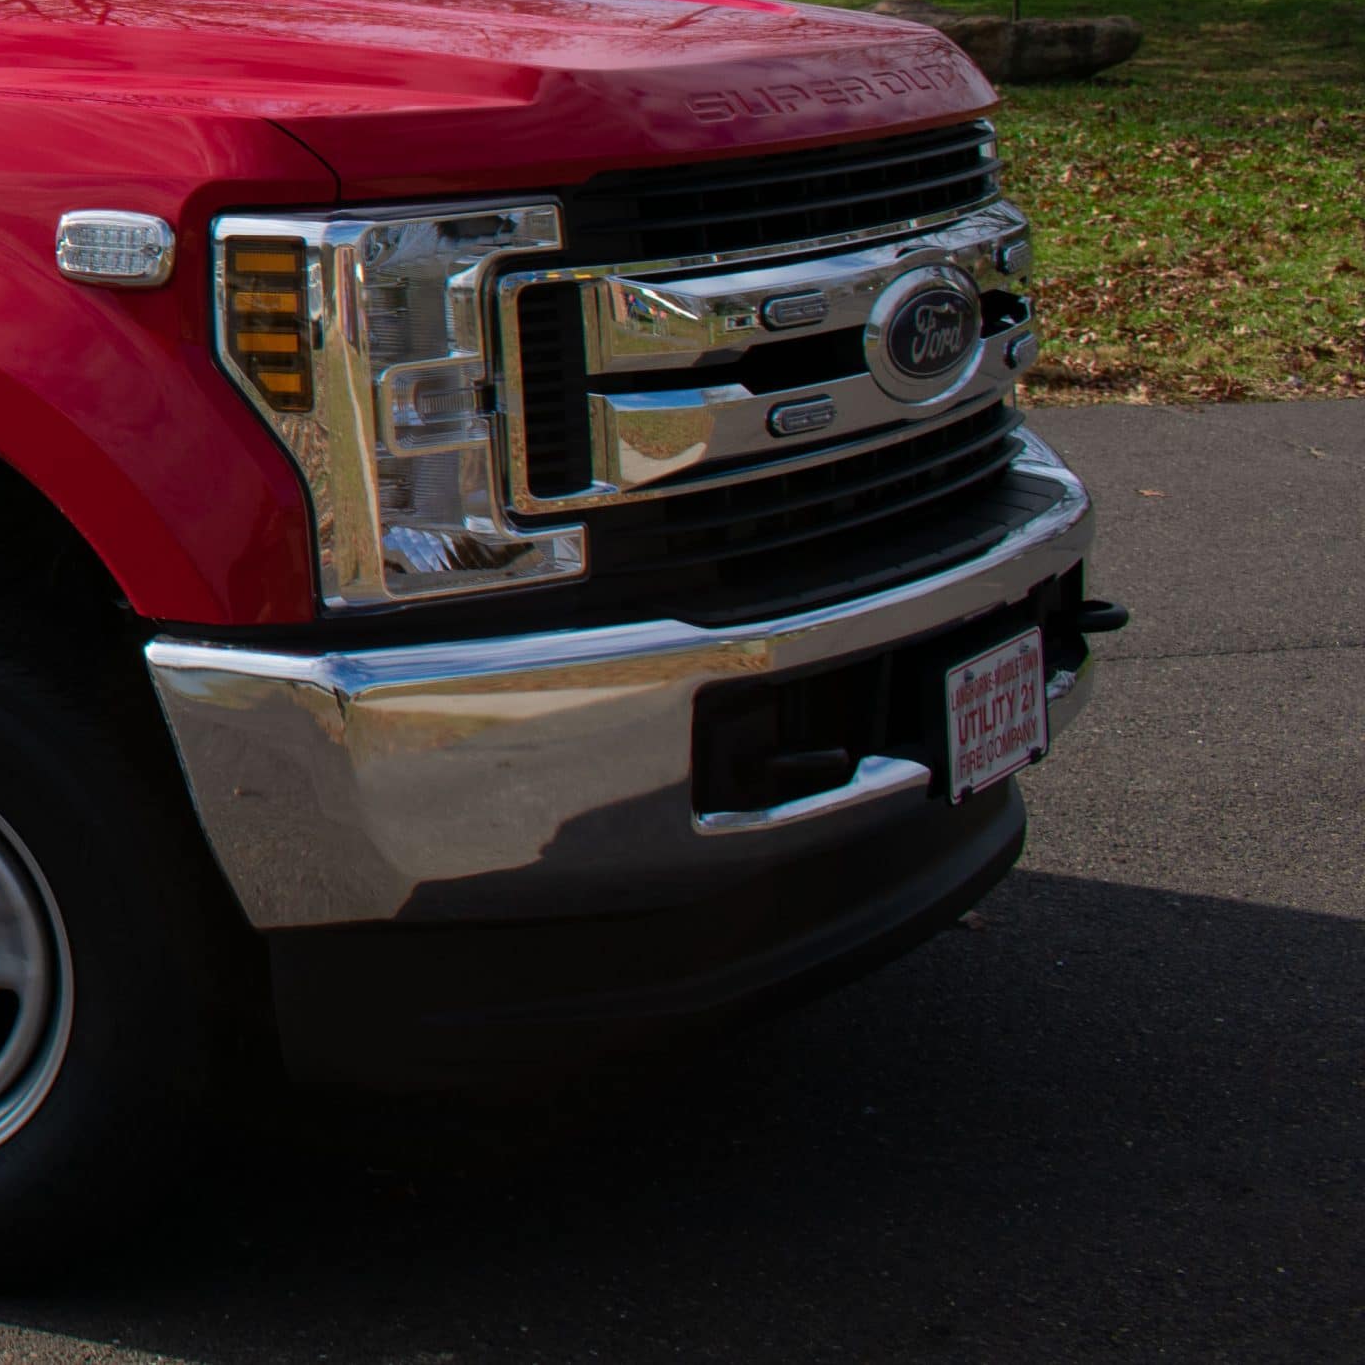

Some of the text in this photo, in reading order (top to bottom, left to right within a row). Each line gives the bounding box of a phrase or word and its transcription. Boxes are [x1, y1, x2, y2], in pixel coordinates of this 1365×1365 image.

[685, 74, 882, 124] SUPER
[912, 302, 964, 364] Ford
[957, 680, 1036, 747] UTILITY 21
[959, 715, 1038, 780] FIRE COMPANY
